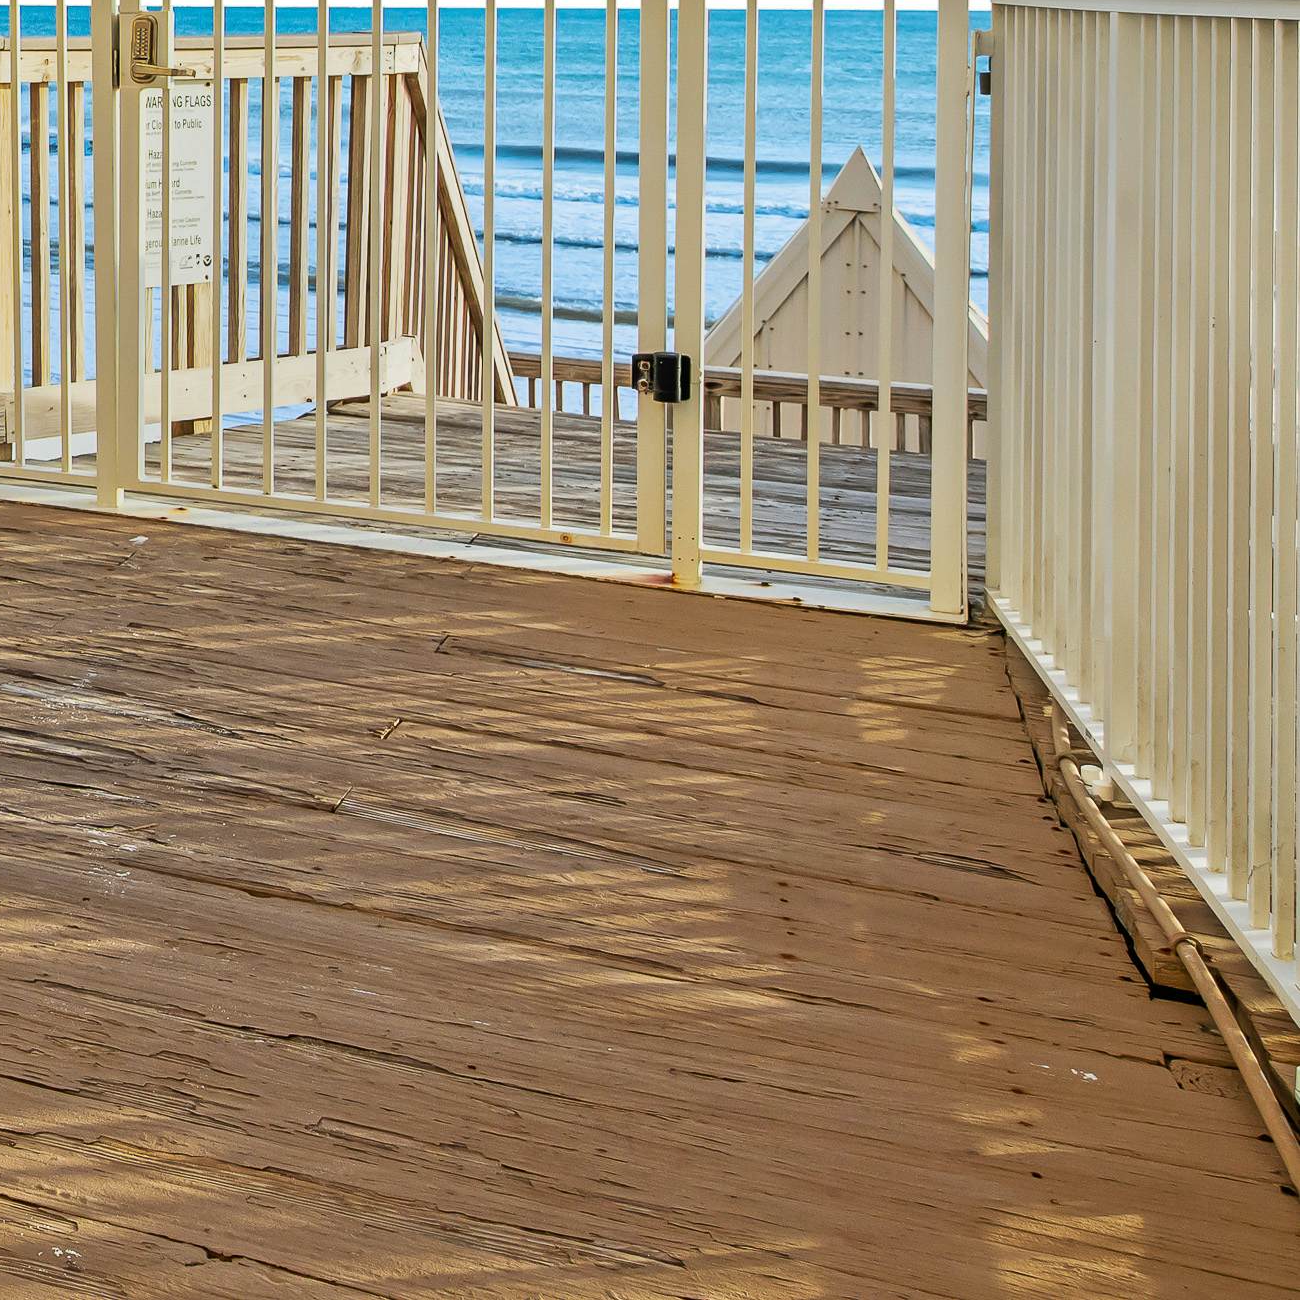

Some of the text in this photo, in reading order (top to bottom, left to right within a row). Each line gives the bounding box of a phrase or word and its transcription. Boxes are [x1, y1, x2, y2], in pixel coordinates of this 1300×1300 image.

[185, 95, 212, 108] FLAGS
[174, 120, 181, 129] to
[182, 118, 202, 129] Public
[190, 234, 202, 246] Life
